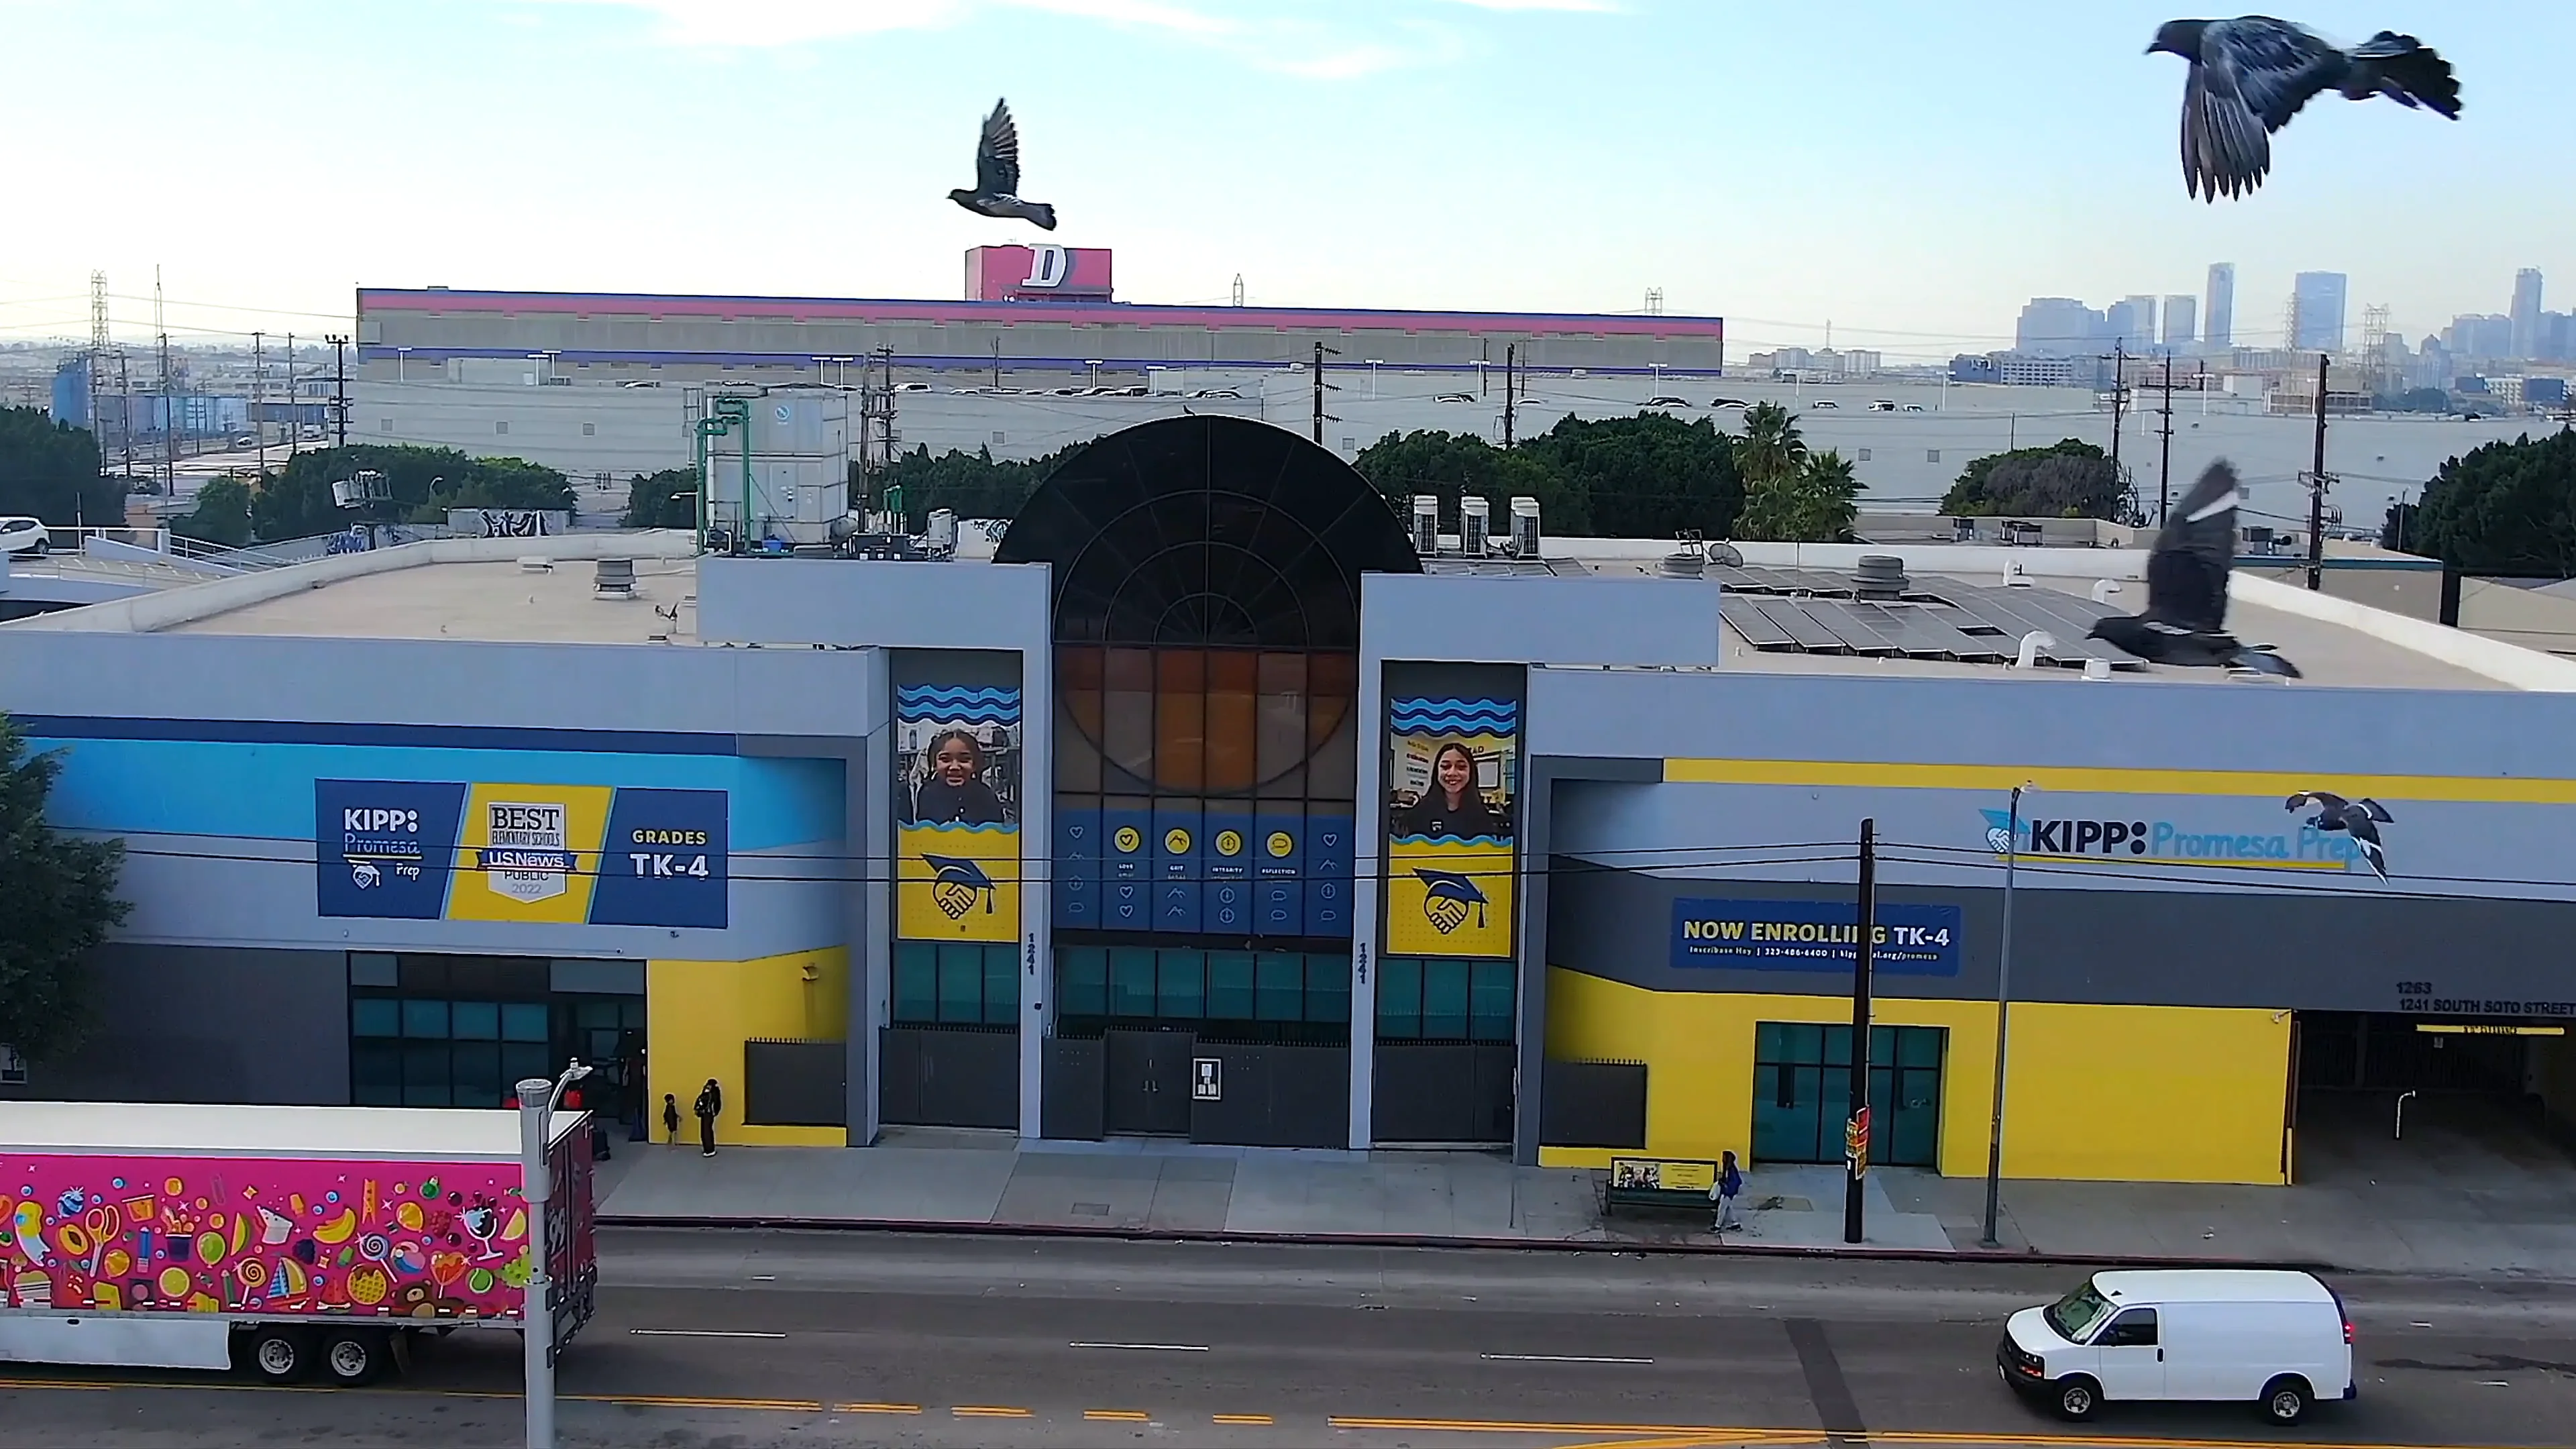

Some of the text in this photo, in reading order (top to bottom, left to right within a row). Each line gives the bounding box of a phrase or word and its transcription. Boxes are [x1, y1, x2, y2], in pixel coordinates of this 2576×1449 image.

[1020, 244, 1068, 287] D
[345, 809, 417, 832] KIPP:
[492, 807, 559, 830] BEST
[345, 833, 421, 853] Promesa
[633, 830, 706, 845] GRADES
[2031, 820, 2361, 873] KIPP: Promesa Prep
[396, 863, 419, 880] Prep
[504, 871, 549, 881] PUBLIC
[630, 853, 709, 880] TK-4
[512, 883, 541, 894] 2022
[1684, 921, 1743, 939] NOW
[1894, 927, 1949, 946] TK-4
[1026, 932, 1035, 975] 1241
[1358, 942, 1367, 985] 1241
[2396, 981, 2432, 994] 1263
[2400, 998, 2576, 1015] 1241 SOUTH SOTO STREET
